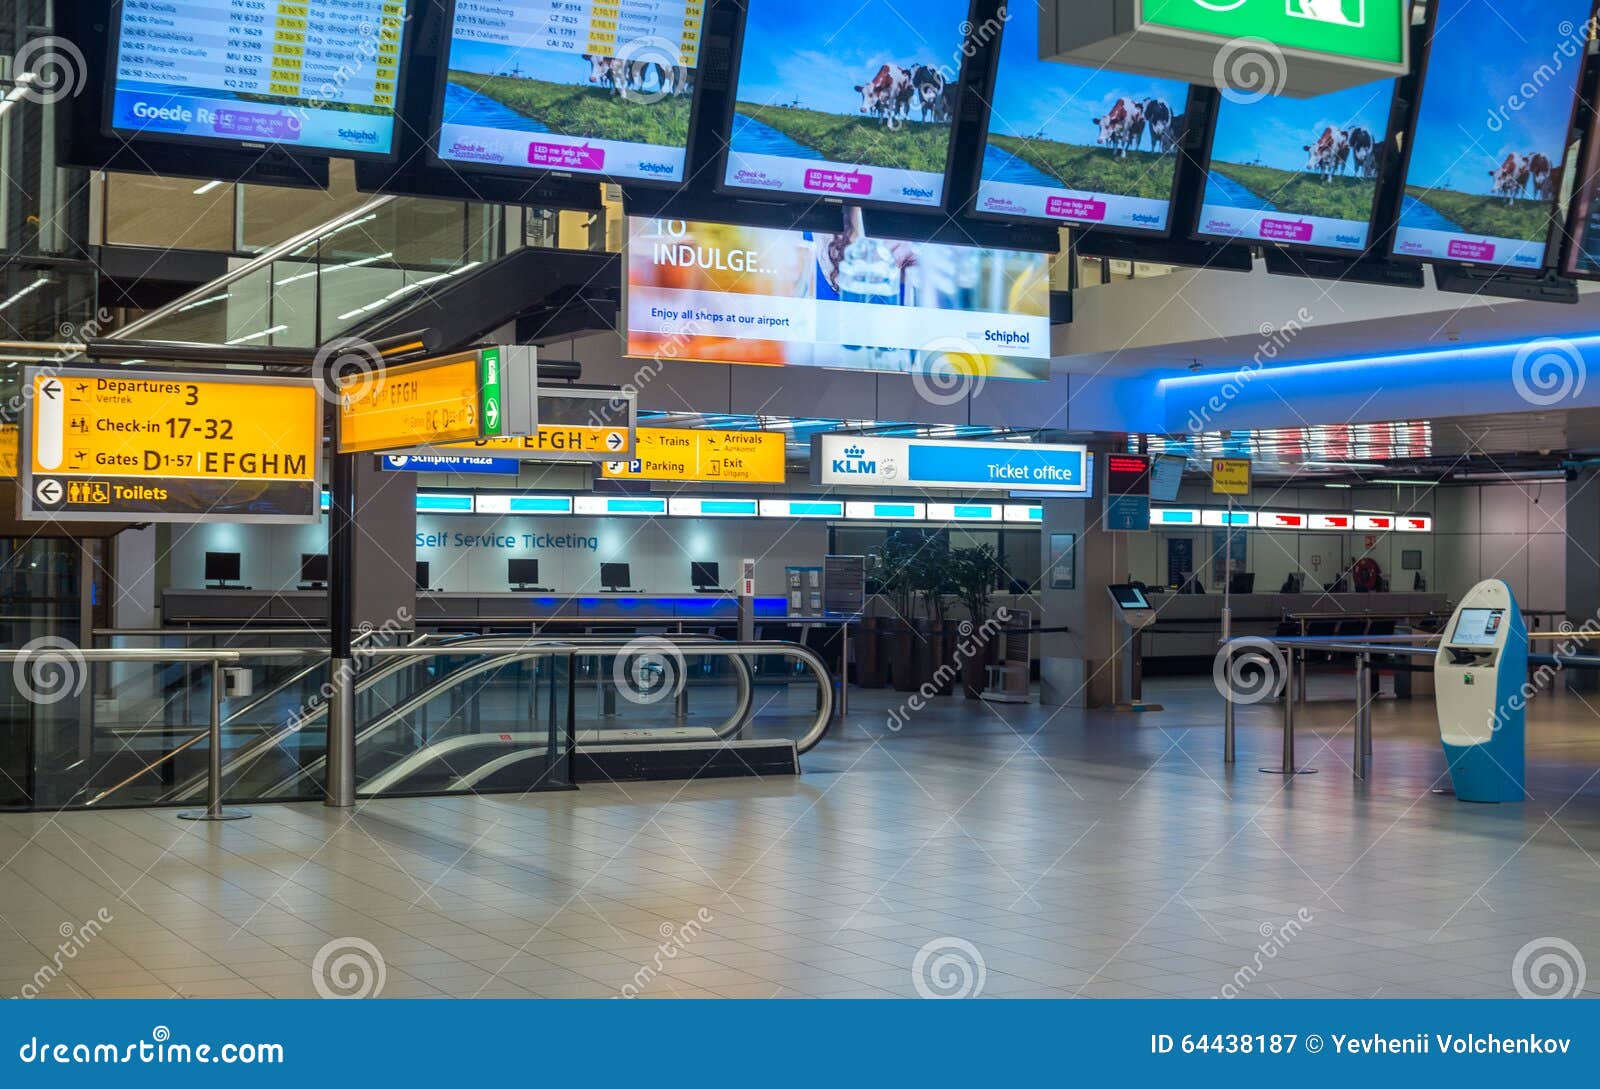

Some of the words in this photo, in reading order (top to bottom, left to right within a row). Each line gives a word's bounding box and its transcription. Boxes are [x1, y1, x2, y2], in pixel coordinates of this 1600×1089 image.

[457, 2, 478, 11] 07:15
[479, 5, 513, 16] Hamburg
[455, 14, 476, 24] 07:15
[477, 17, 506, 27] Munich
[455, 27, 475, 36] 07:15
[133, 102, 192, 122] Goede
[197, 110, 232, 126] Reis
[338, 128, 376, 140] Schiphol
[639, 162, 674, 174] Schiphol
[902, 187, 933, 198] Schiphol
[1132, 213, 1160, 224] Schiphol
[653, 243, 777, 274] INDULGE...
[652, 308, 678, 320] Enjoy
[682, 310, 692, 320] all
[696, 311, 724, 324] shops
[726, 314, 736, 322] at
[738, 315, 754, 324] our
[757, 314, 790, 328] airport
[984, 329, 1030, 344] Schiphol
[96, 394, 132, 404] Vertrek
[97, 378, 180, 394] Departures
[186, 386, 198, 406] 3
[96, 418, 160, 433] Check-in
[660, 436, 690, 446] Trains
[724, 433, 762, 444] Arrivals
[96, 452, 138, 466] Gates
[724, 458, 742, 468] Exit
[646, 461, 685, 474] Parking
[832, 460, 876, 474] KLM
[988, 464, 1029, 480] Ticket
[1034, 466, 1072, 480] office
[114, 485, 168, 500] Toilets
[416, 532, 448, 548] Self
[454, 532, 516, 548] Service
[522, 534, 598, 552] Ticketing
